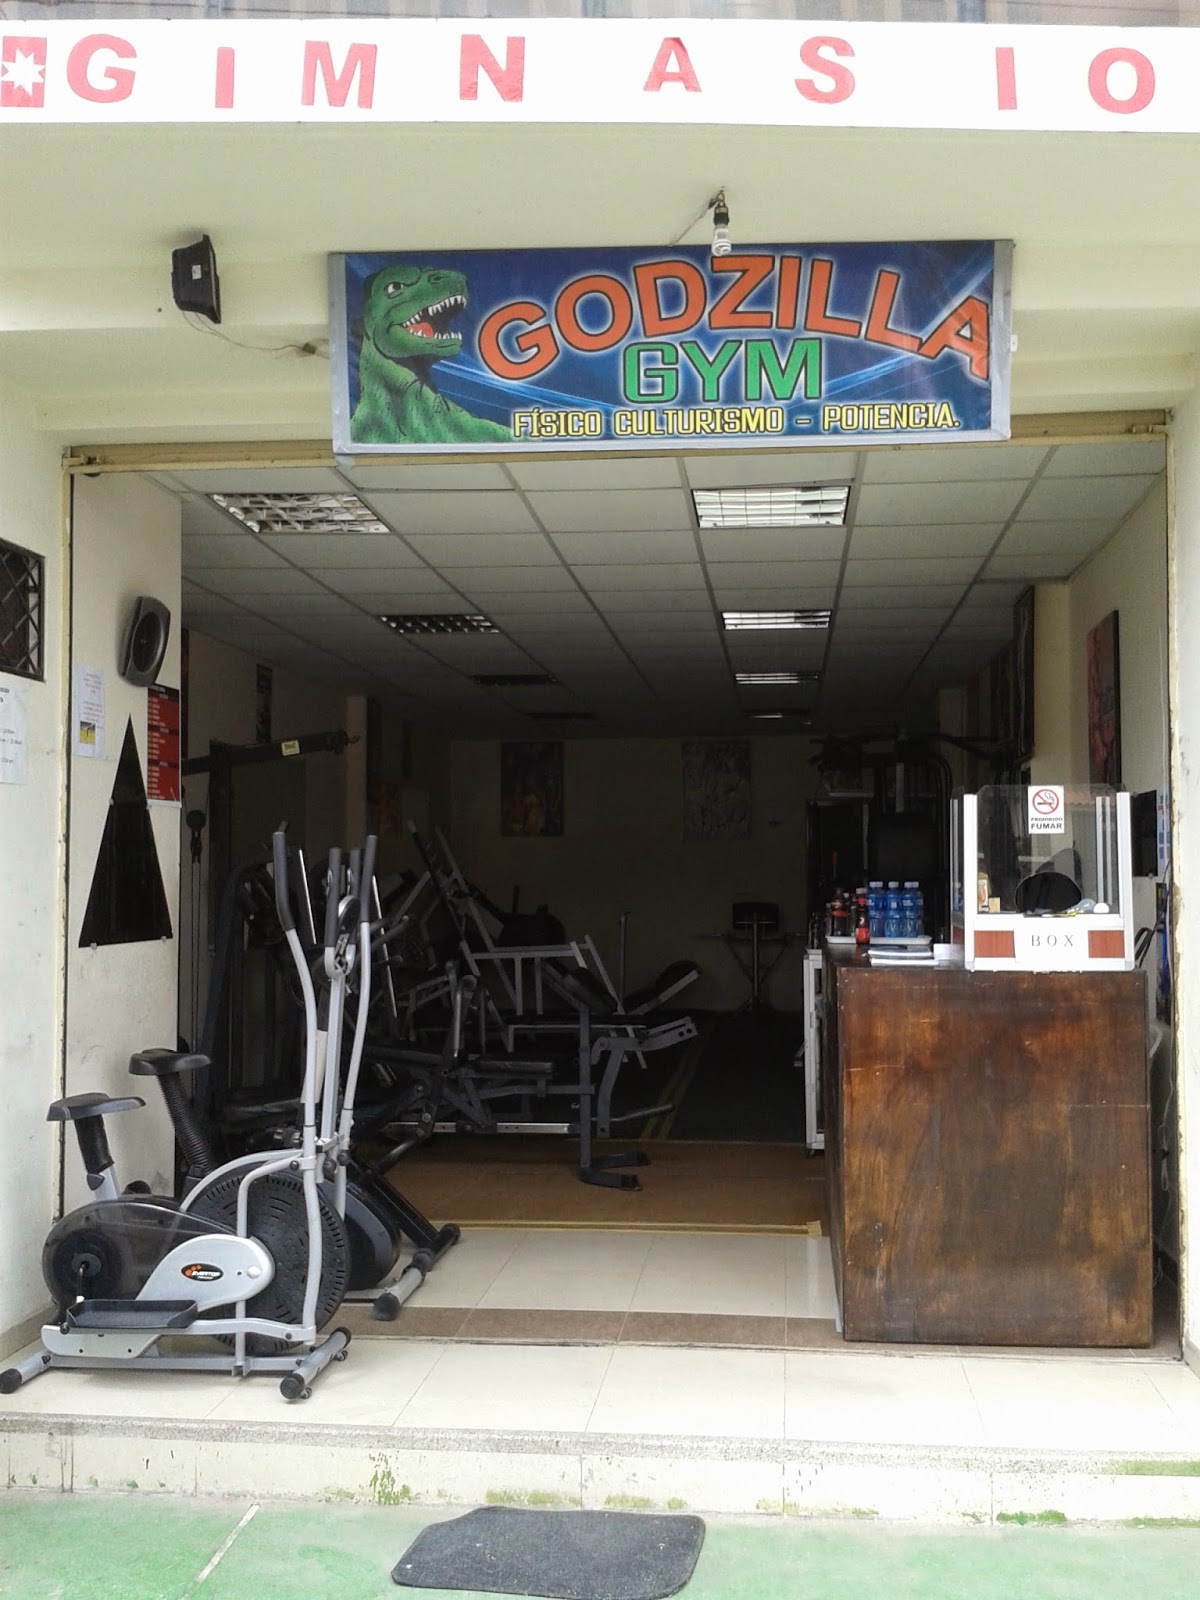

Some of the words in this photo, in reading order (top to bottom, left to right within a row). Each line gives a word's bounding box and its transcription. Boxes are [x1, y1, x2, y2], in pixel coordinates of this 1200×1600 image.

[66, 33, 1156, 114] GIMNASIO
[477, 255, 990, 381] GODZILLA
[623, 338, 824, 404] GYM
[513, 407, 602, 437] FÍSICO
[613, 406, 784, 436] CULTURISMO
[822, 401, 961, 431] POTENCIA.
[1030, 822, 1062, 830] FUMAR
[1030, 934, 1075, 947] BOX
